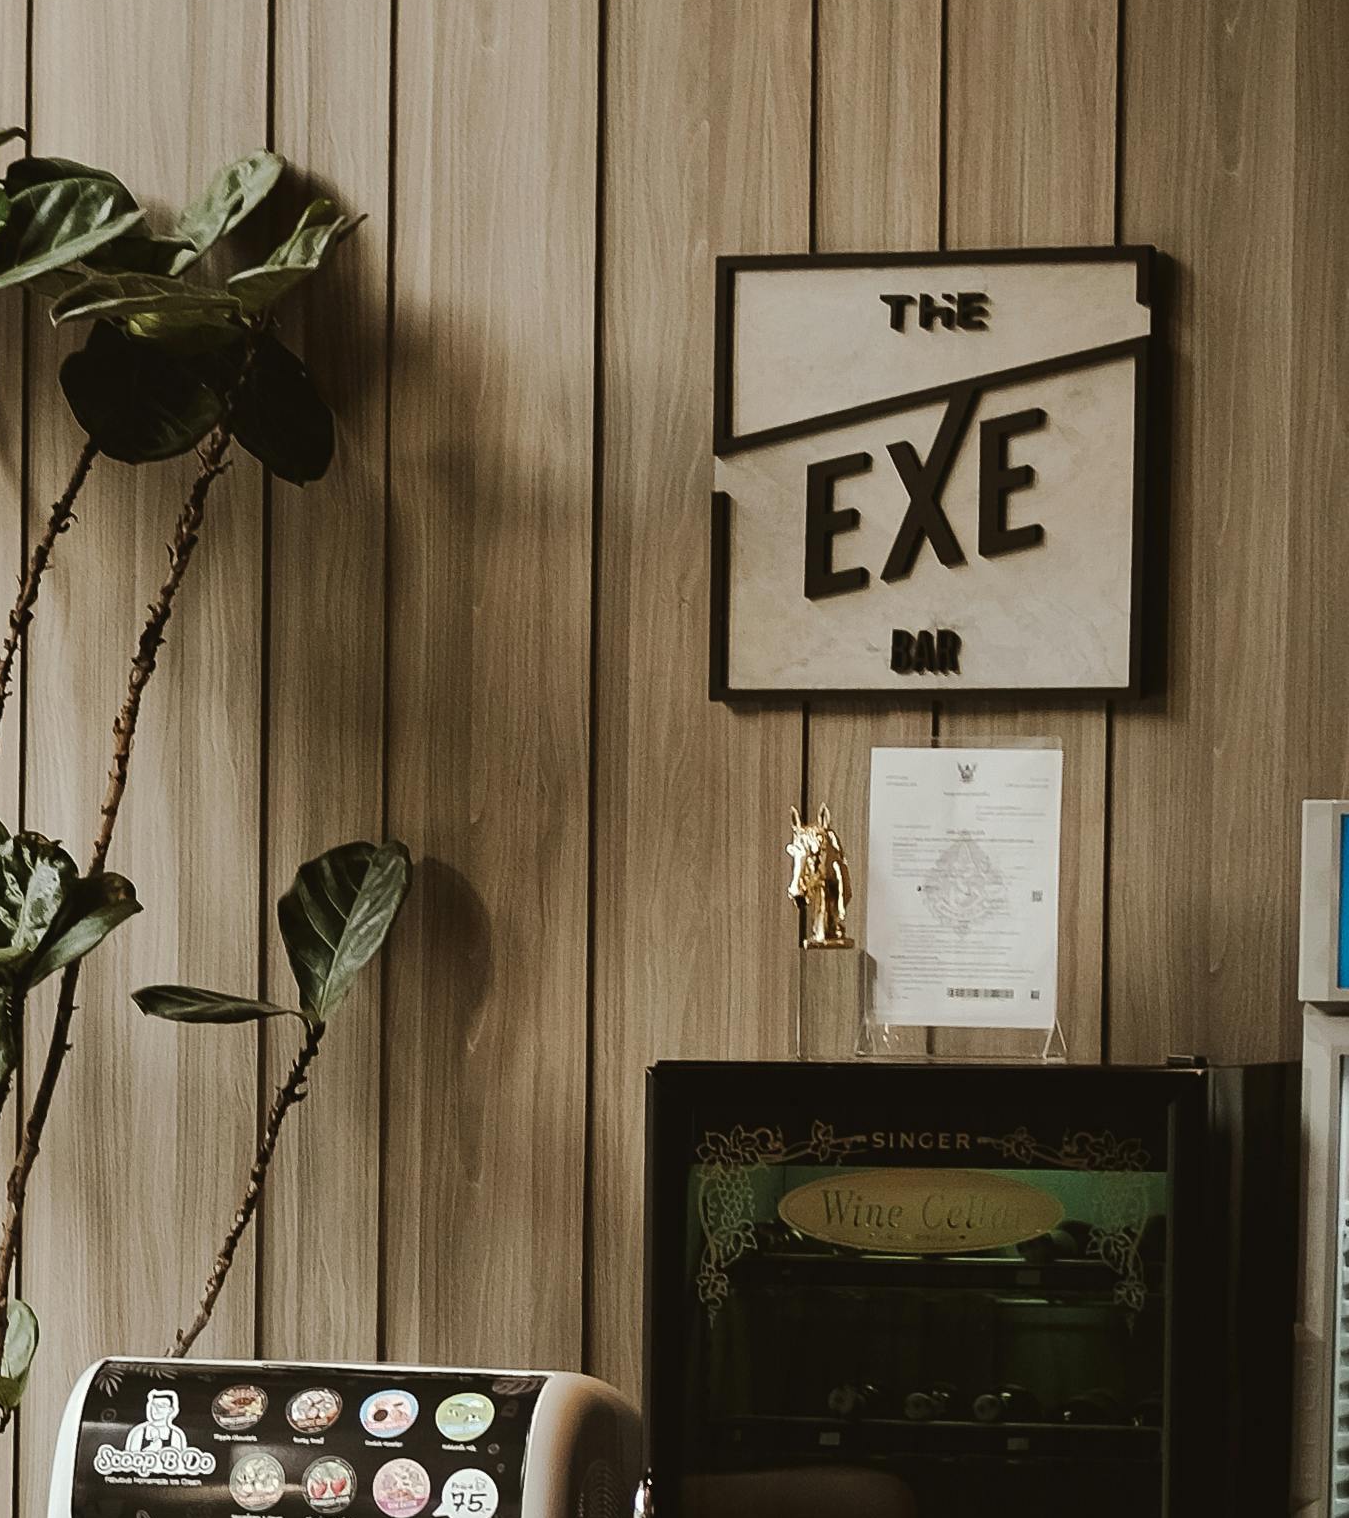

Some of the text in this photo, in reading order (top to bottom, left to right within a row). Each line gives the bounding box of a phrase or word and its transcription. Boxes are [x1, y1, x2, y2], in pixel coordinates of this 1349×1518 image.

[879, 291, 992, 333] THE
[803, 387, 1047, 602] EXE
[889, 628, 963, 675] BAR
[871, 1131, 971, 1150] SINGER
[821, 1188, 904, 1229] Wine
[96, 1447, 214, 1475] Scoop B Do
